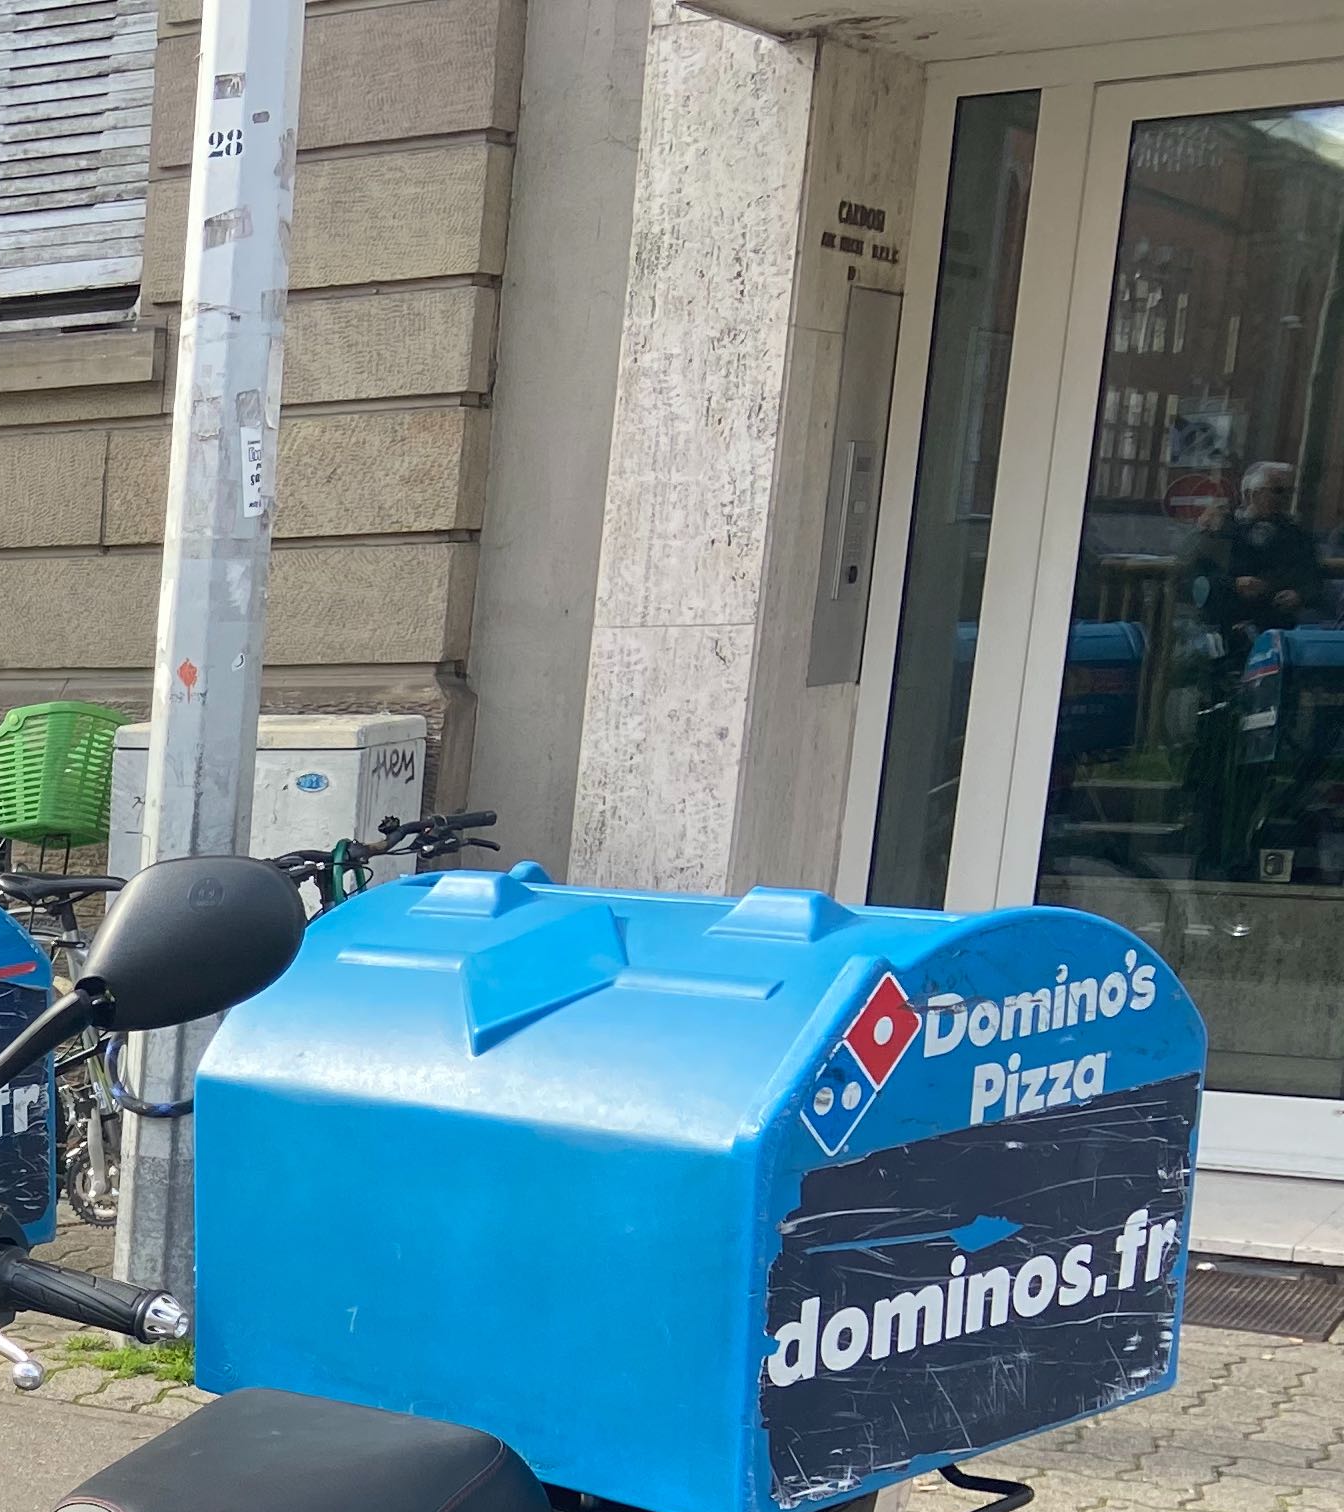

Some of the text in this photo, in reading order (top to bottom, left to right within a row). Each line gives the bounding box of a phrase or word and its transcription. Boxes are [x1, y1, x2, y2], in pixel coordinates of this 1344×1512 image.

[207, 128, 244, 159] 28
[921, 949, 1157, 1058] Domino's
[969, 1053, 1106, 1127] Pizza
[767, 1209, 1179, 1389] dominos.fr
